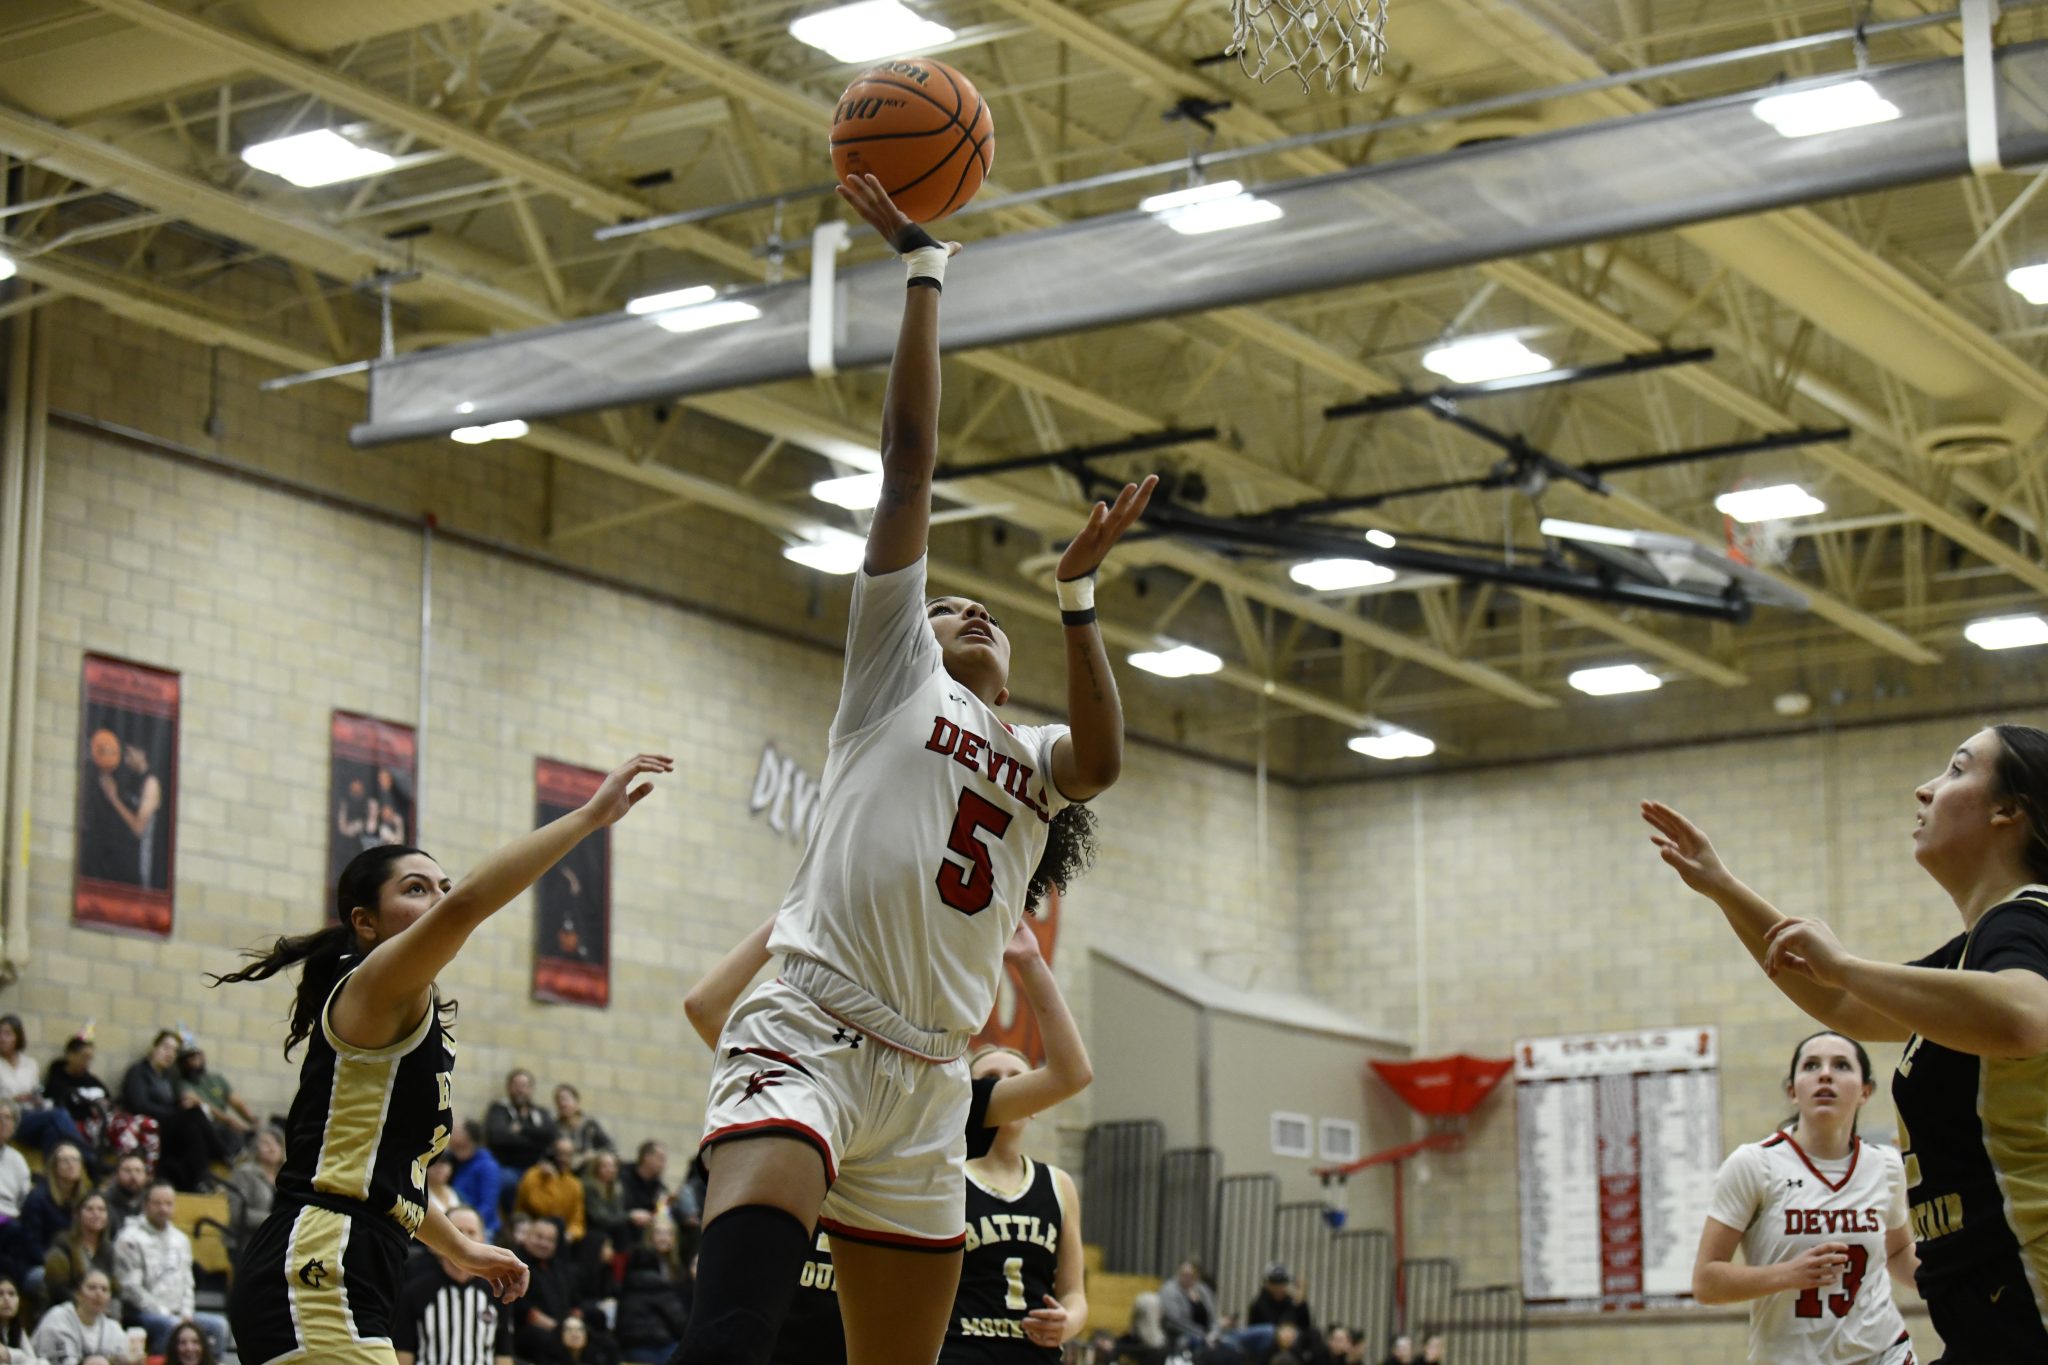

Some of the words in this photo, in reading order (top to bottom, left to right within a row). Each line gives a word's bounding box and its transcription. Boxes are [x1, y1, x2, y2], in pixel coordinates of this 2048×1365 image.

[935, 785, 1014, 916] 5
[1784, 1208, 1880, 1236] DEVILS
[1003, 1256, 1028, 1310] 1
